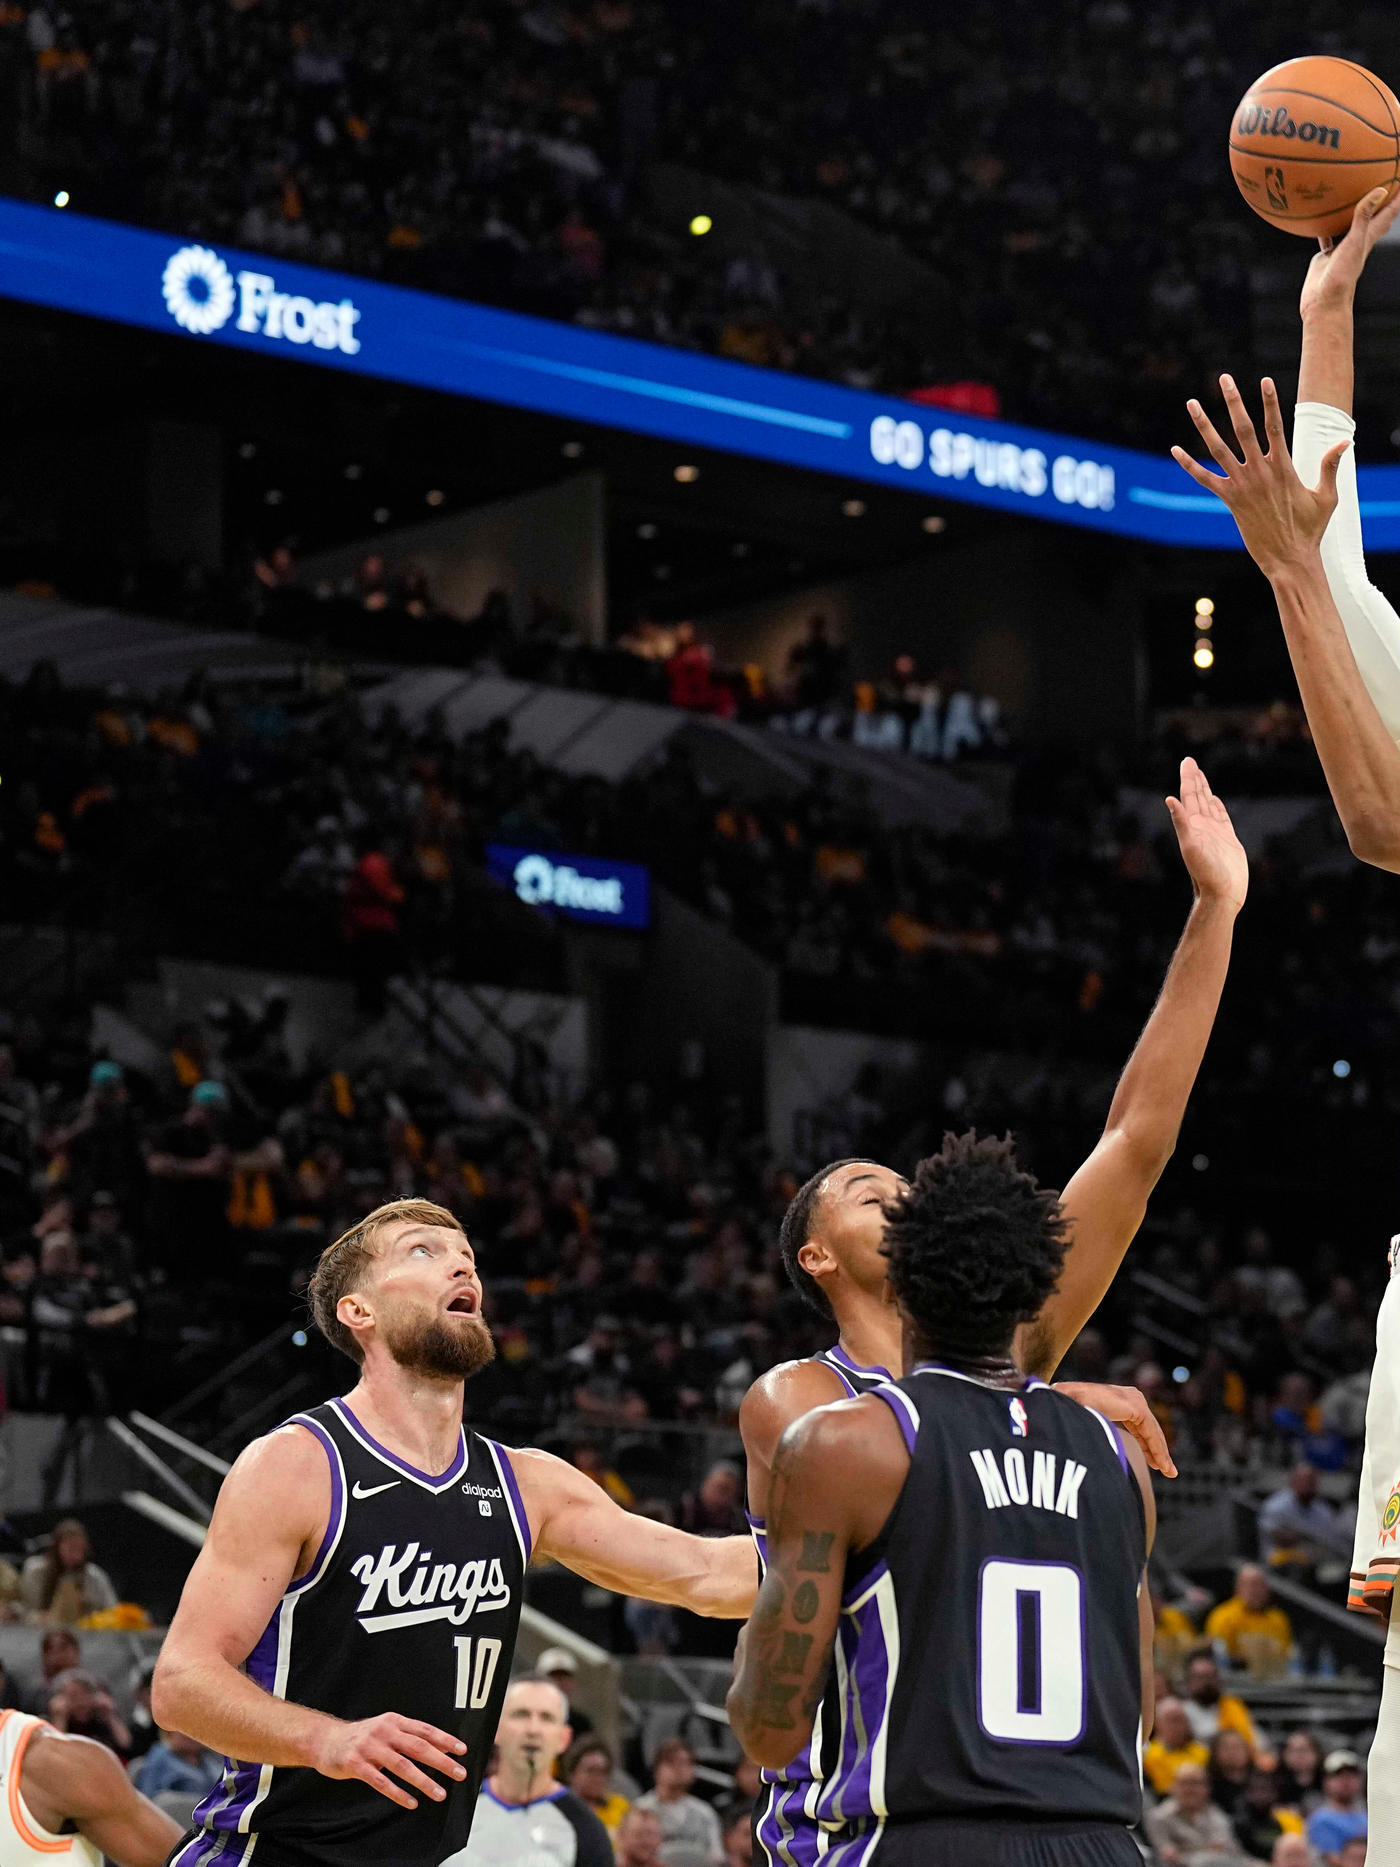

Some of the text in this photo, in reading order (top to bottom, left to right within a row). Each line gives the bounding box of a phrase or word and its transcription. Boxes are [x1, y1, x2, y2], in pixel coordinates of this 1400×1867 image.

[1237, 105, 1341, 150] Wilson
[236, 269, 361, 355] Frost
[870, 415, 1115, 512] GO SPURS GO!
[461, 1482, 503, 1499] dialpad
[969, 1447, 1088, 1520] MONK
[350, 1541, 511, 1634] Kings
[453, 1634, 503, 1710] 10
[978, 1556, 1087, 1746] 0
